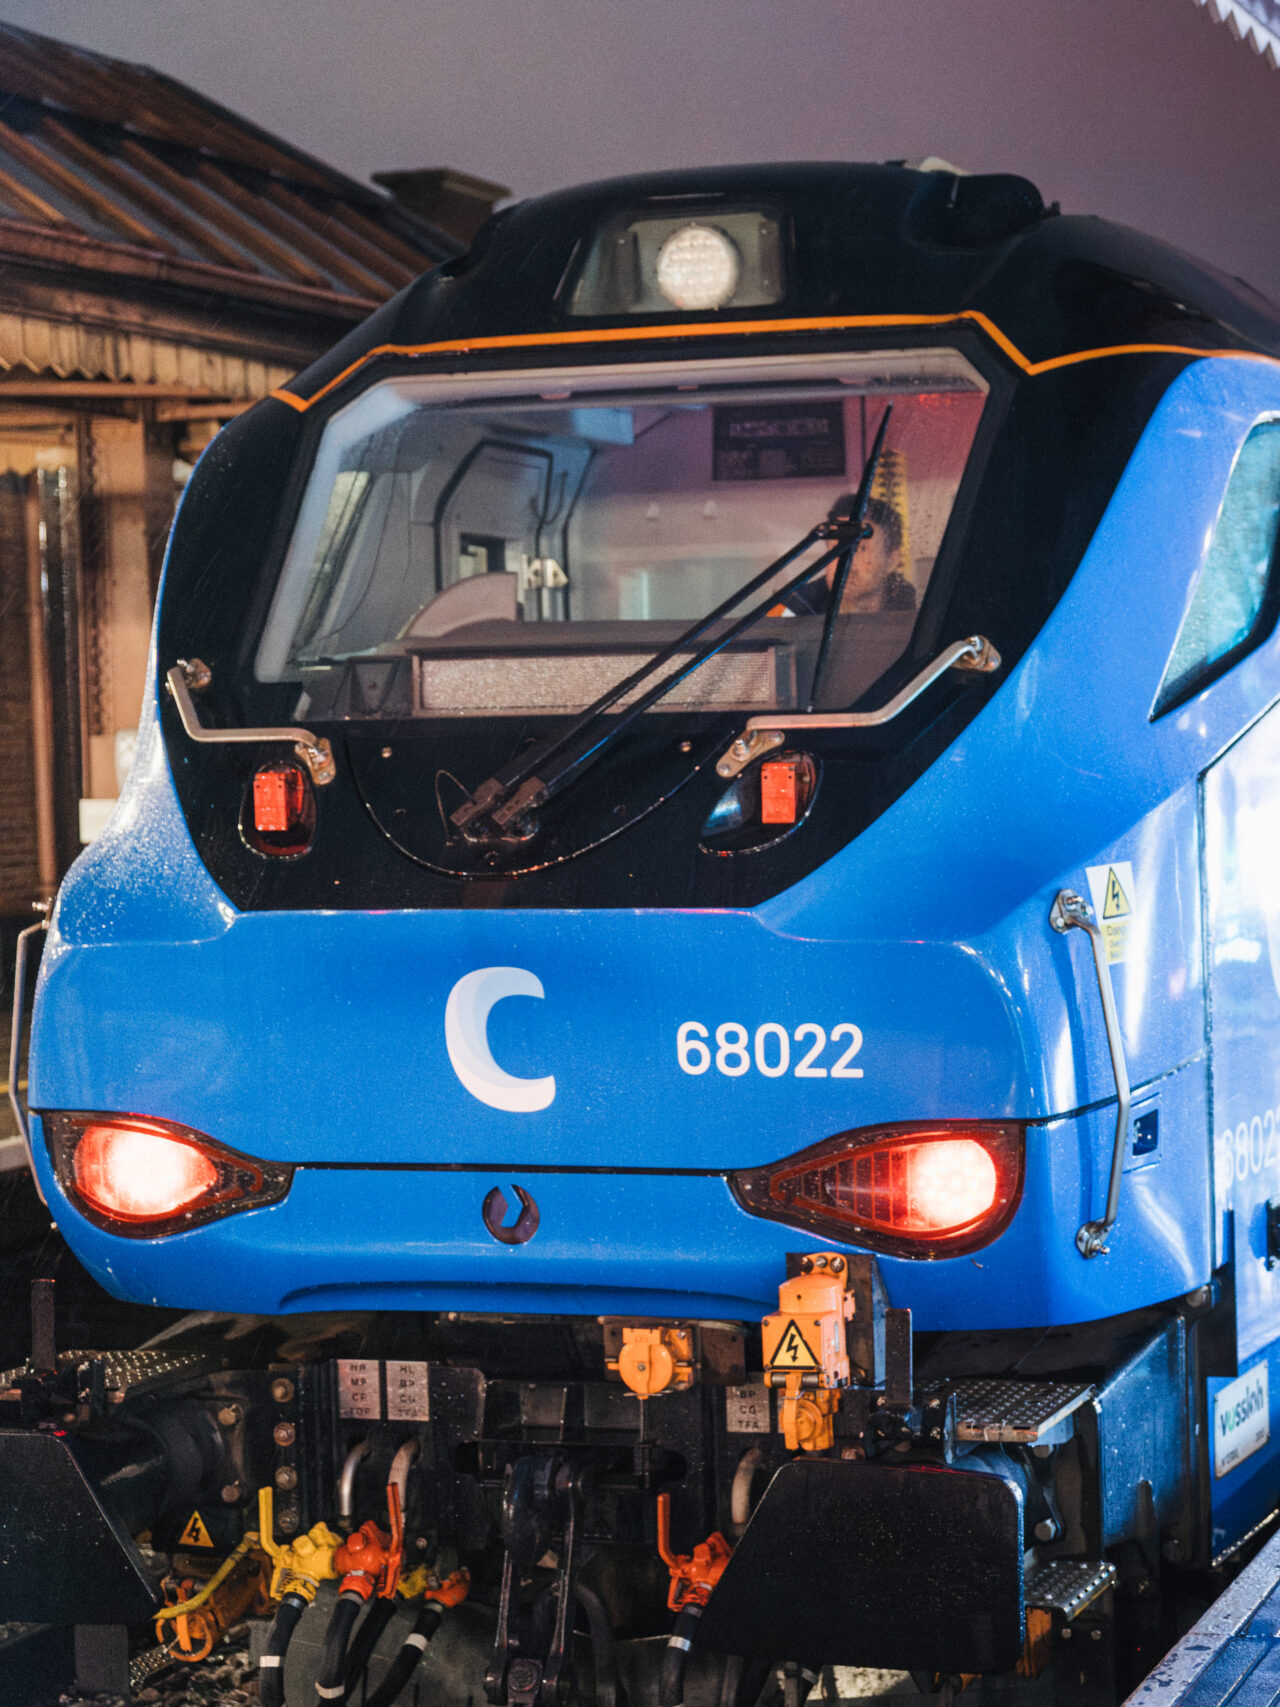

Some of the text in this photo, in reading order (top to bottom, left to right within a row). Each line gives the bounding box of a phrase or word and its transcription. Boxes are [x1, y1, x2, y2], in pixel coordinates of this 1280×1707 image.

[676, 1020, 864, 1079] 68022
[739, 1389, 756, 1399] BP
[739, 1404, 757, 1415] CG
[737, 1419, 760, 1430] TFA
